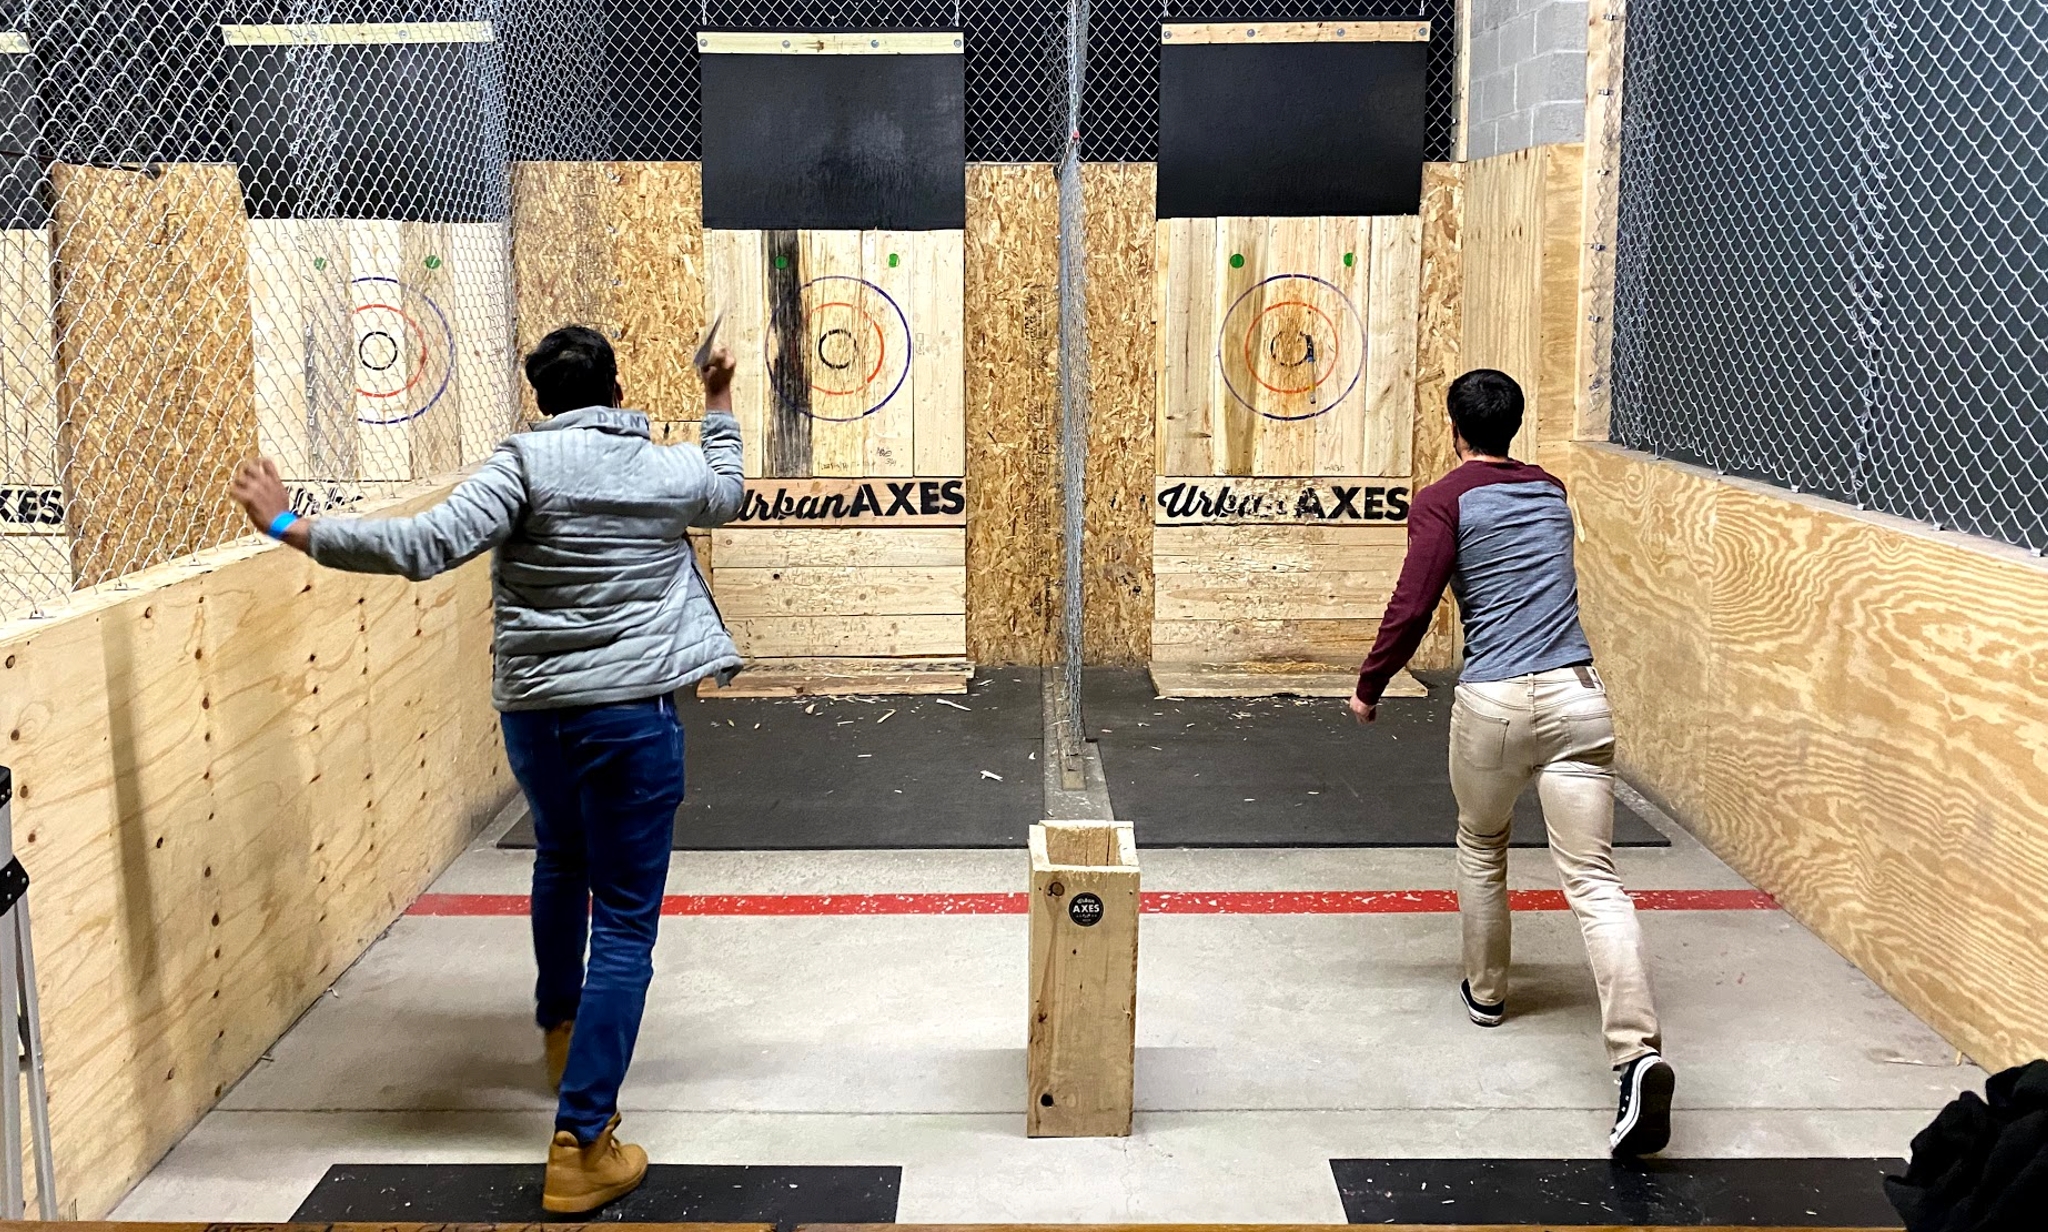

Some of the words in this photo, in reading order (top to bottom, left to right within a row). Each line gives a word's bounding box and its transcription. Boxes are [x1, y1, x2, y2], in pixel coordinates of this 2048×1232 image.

[849, 480, 965, 517] AXES
[1295, 485, 1410, 521] AXES
[1073, 905, 1100, 913] AXES
